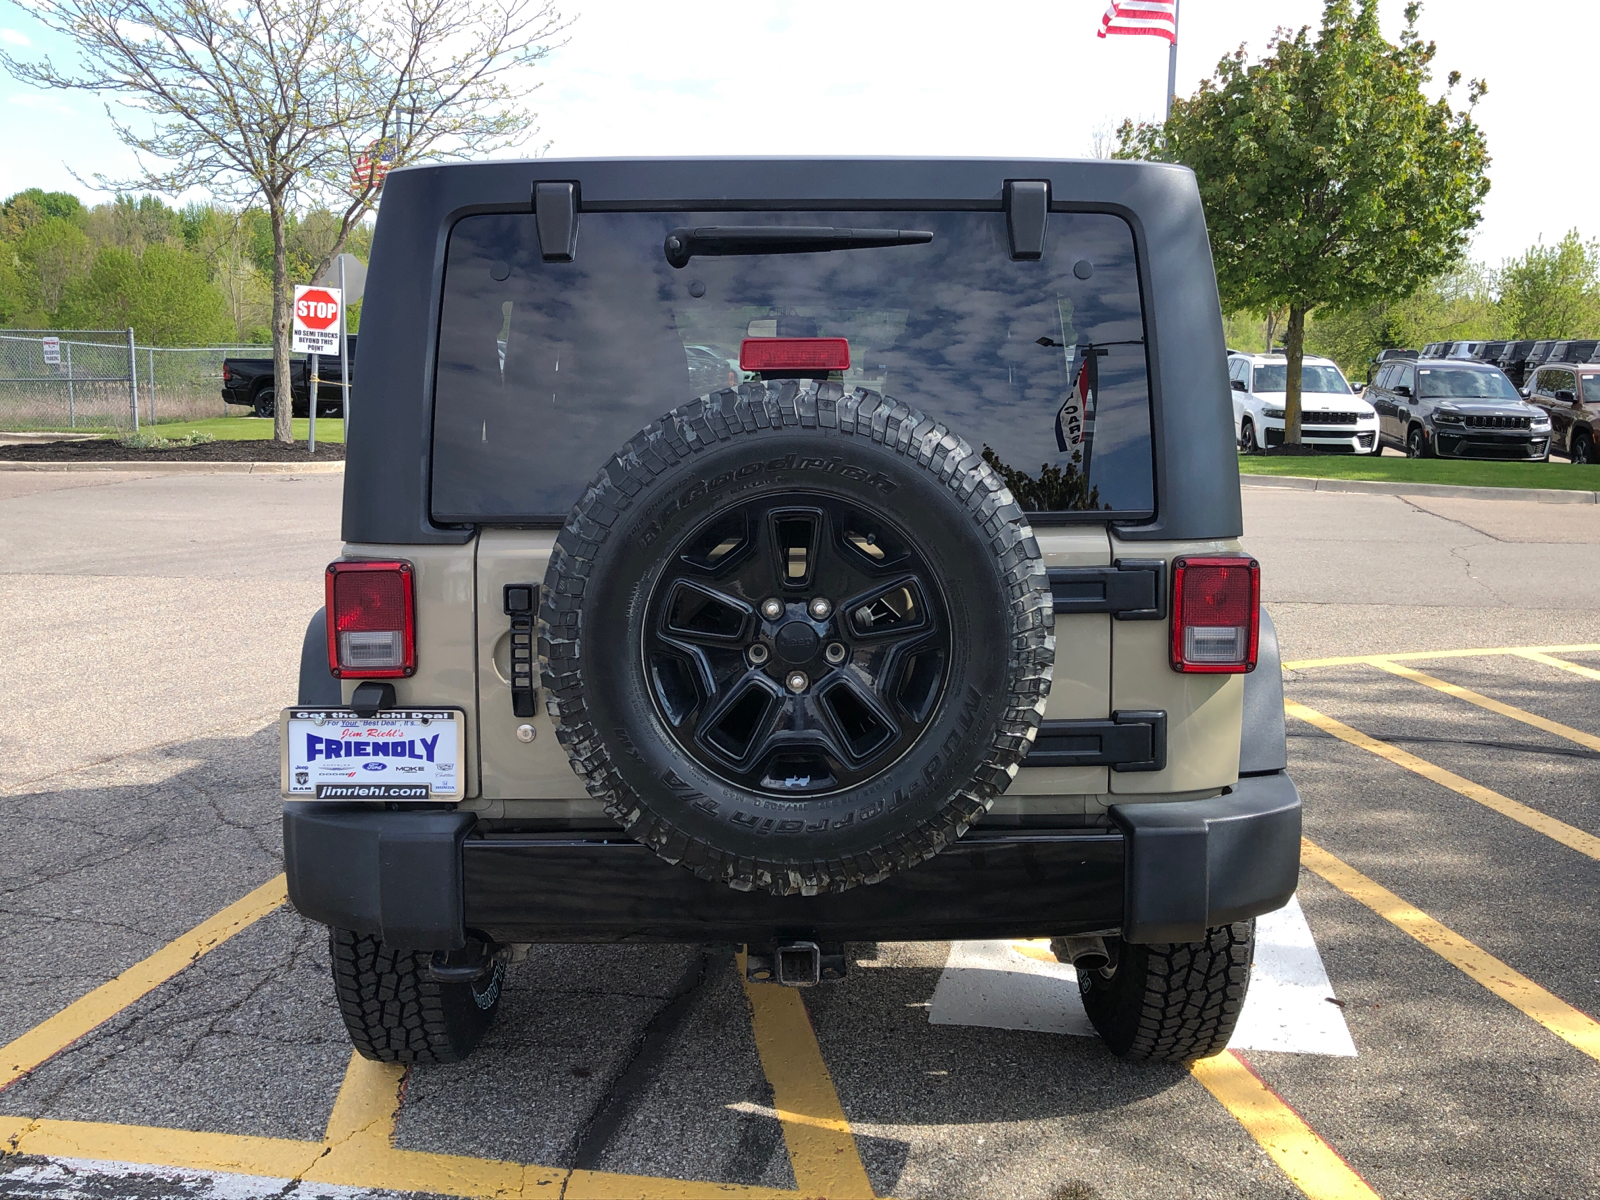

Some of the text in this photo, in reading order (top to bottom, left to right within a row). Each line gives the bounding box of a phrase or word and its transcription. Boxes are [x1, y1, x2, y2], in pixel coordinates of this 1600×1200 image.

[298, 300, 337, 319] STOP
[637, 452, 900, 553] BFGoodrich
[306, 733, 440, 762] FRIENDLY
[340, 728, 404, 740] Jim Riehl's
[727, 682, 987, 837] Mud-Terrain
[320, 786, 426, 798] jimriehl.com
[656, 764, 723, 820] T/A
